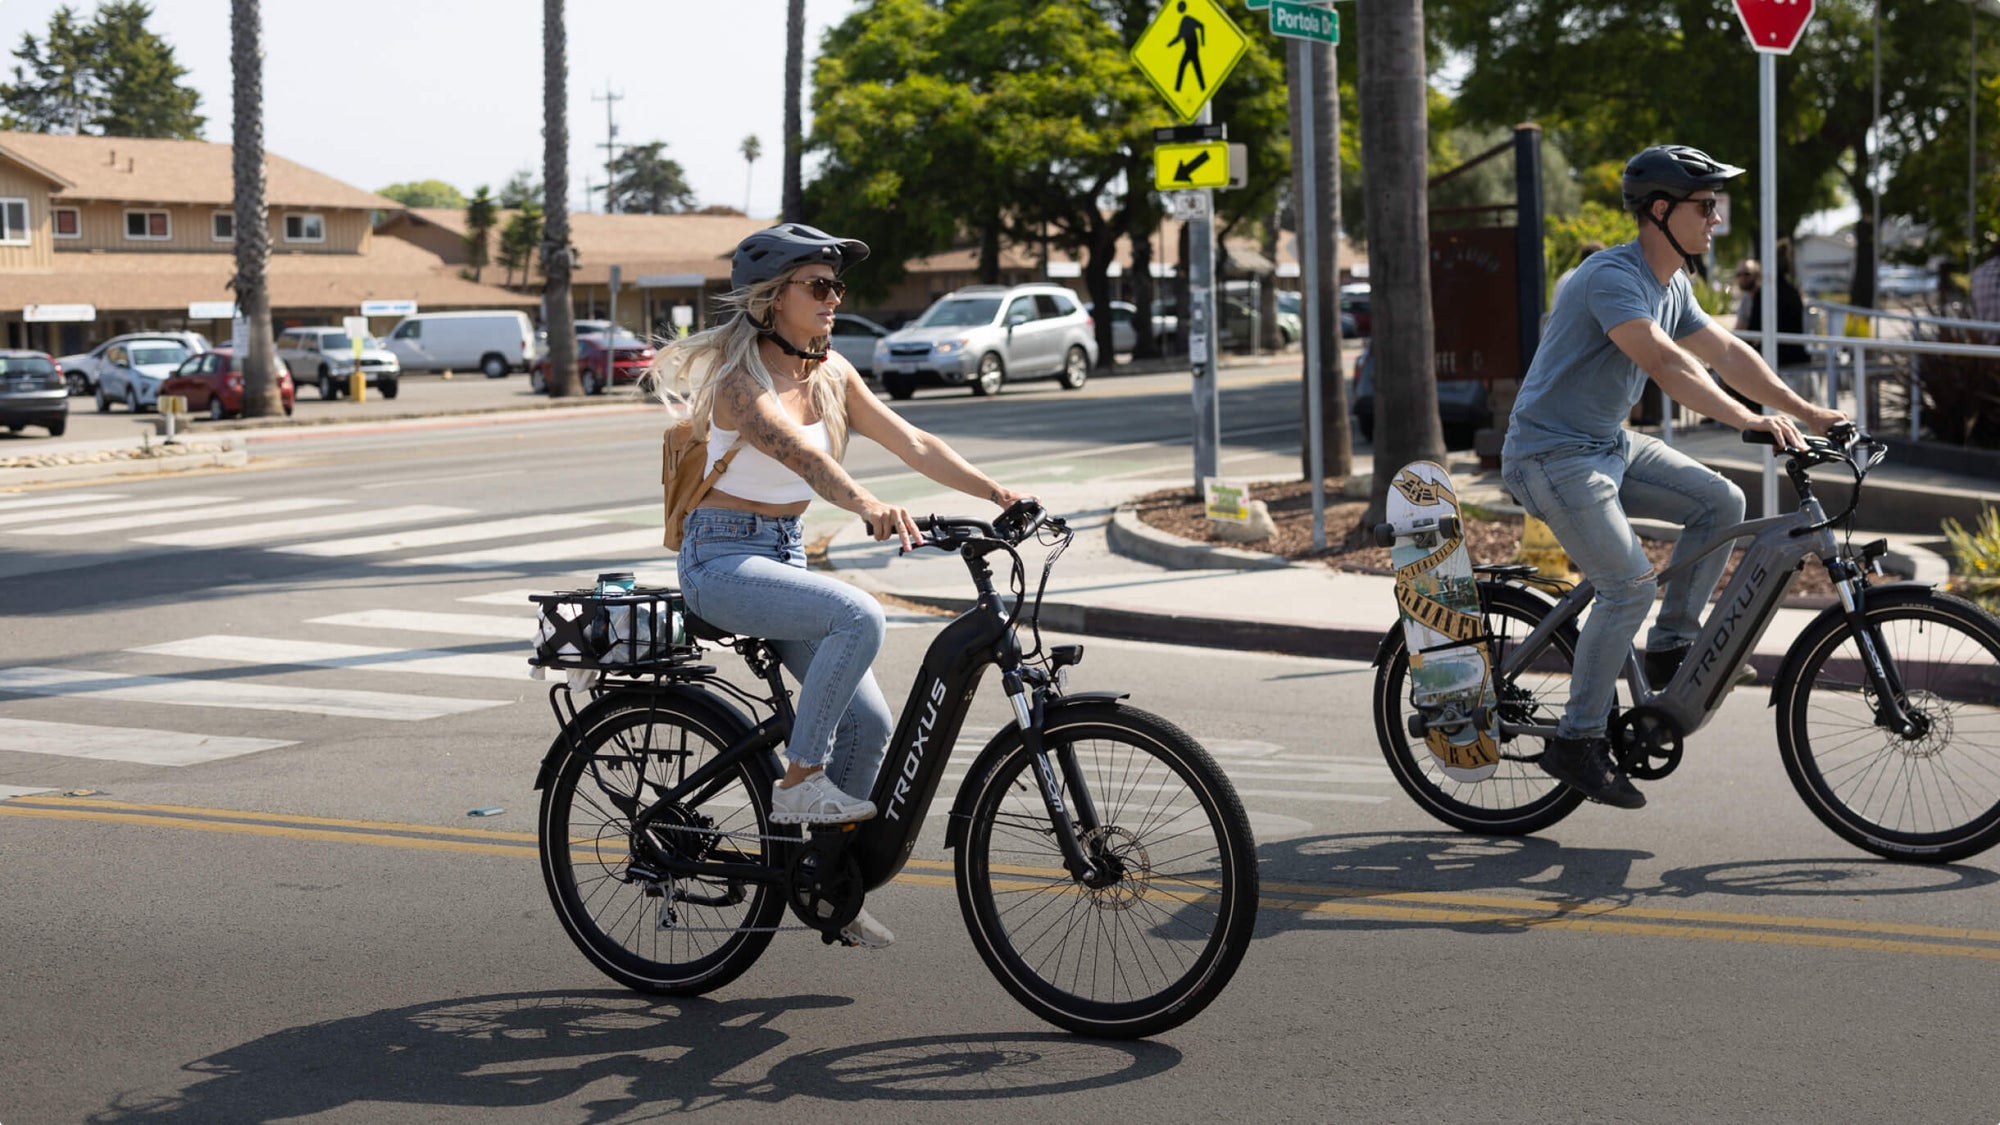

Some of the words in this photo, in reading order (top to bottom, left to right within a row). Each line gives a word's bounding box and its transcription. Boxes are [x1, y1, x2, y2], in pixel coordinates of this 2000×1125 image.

[1276, 8, 1320, 33] Portola
[1321, 16, 1333, 36] Dr
[1689, 563, 1768, 688] TROXUS
[885, 677, 947, 821] TROXUS
